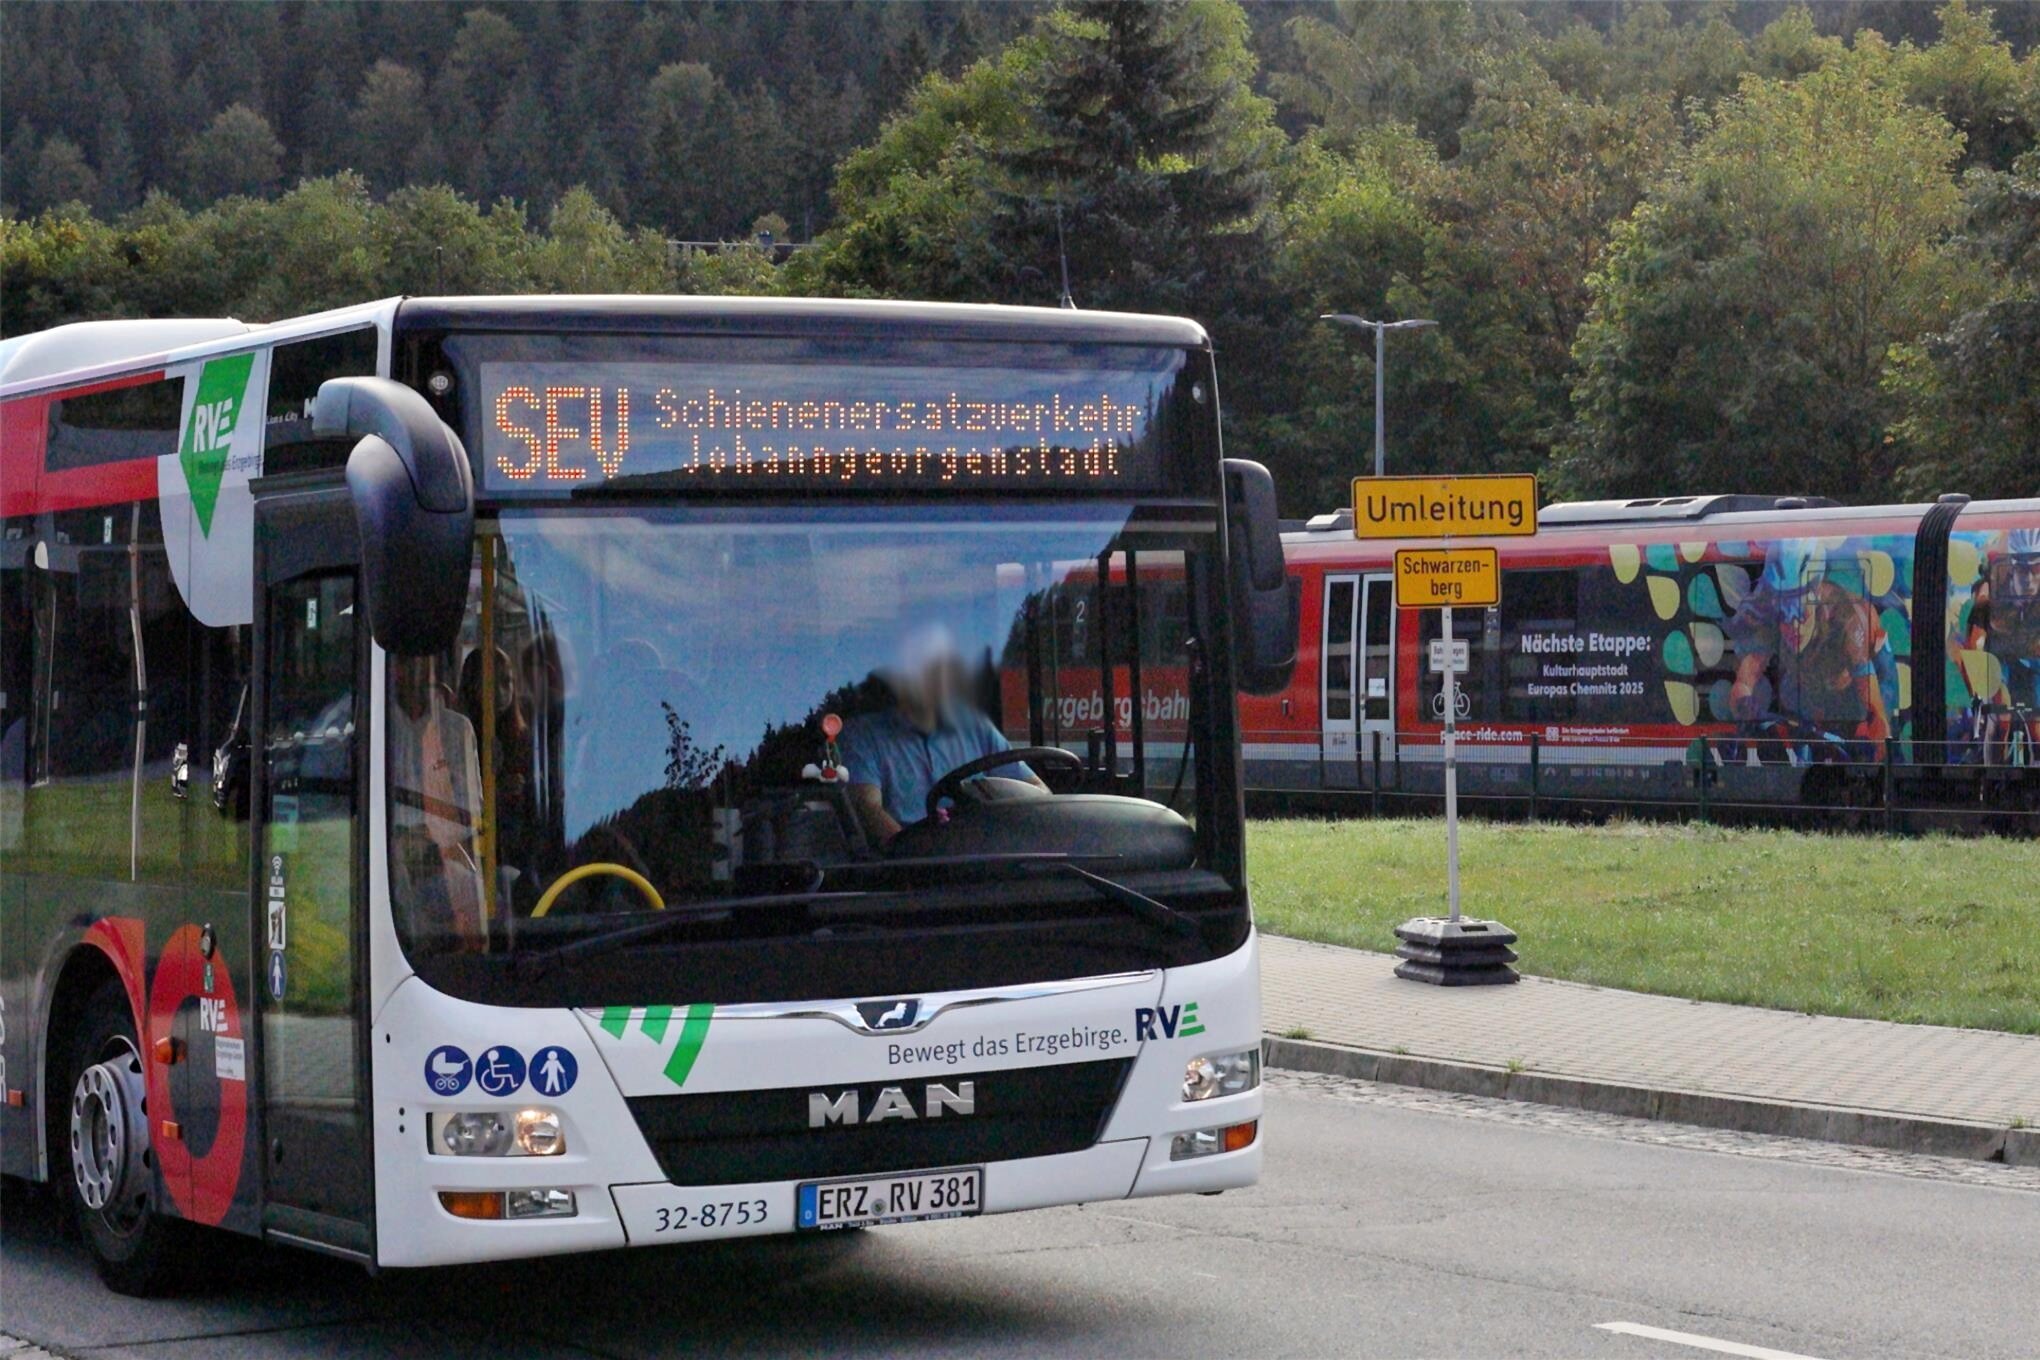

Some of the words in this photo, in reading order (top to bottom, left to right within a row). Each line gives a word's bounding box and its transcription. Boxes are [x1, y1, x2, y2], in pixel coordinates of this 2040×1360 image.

[193, 397, 233, 453] RVE
[656, 388, 1141, 431] Schienenersatzverkehr
[496, 387, 630, 479] SEV
[682, 435, 1119, 480] Johanngeorgenstadt
[1367, 494, 1523, 527] Umleitung
[1403, 557, 1489, 575] Schwarzen-
[1430, 579, 1462, 599] berg
[1076, 600, 1085, 622] 2
[1522, 633, 1585, 653] Nächste
[1589, 632, 1651, 657] Etappe:
[1542, 663, 1629, 680] Kulturhauptstadt
[1528, 683, 1567, 698] Europas
[1570, 682, 1617, 695] Chemnitz
[1619, 681, 1644, 695] 2025
[1440, 727, 1523, 745] pace-ride.com
[200, 997, 229, 1032] RVE
[1135, 1002, 1206, 1042] RVE
[889, 1043, 966, 1065] Bewegt
[972, 1035, 1009, 1057] das
[1016, 1026, 1128, 1056] Erzgebirge.
[808, 1080, 976, 1128] MAN
[819, 1186, 868, 1220] ERZ
[890, 1180, 923, 1213] RV
[930, 1175, 977, 1207] 381
[655, 1200, 768, 1232] 32-8753
